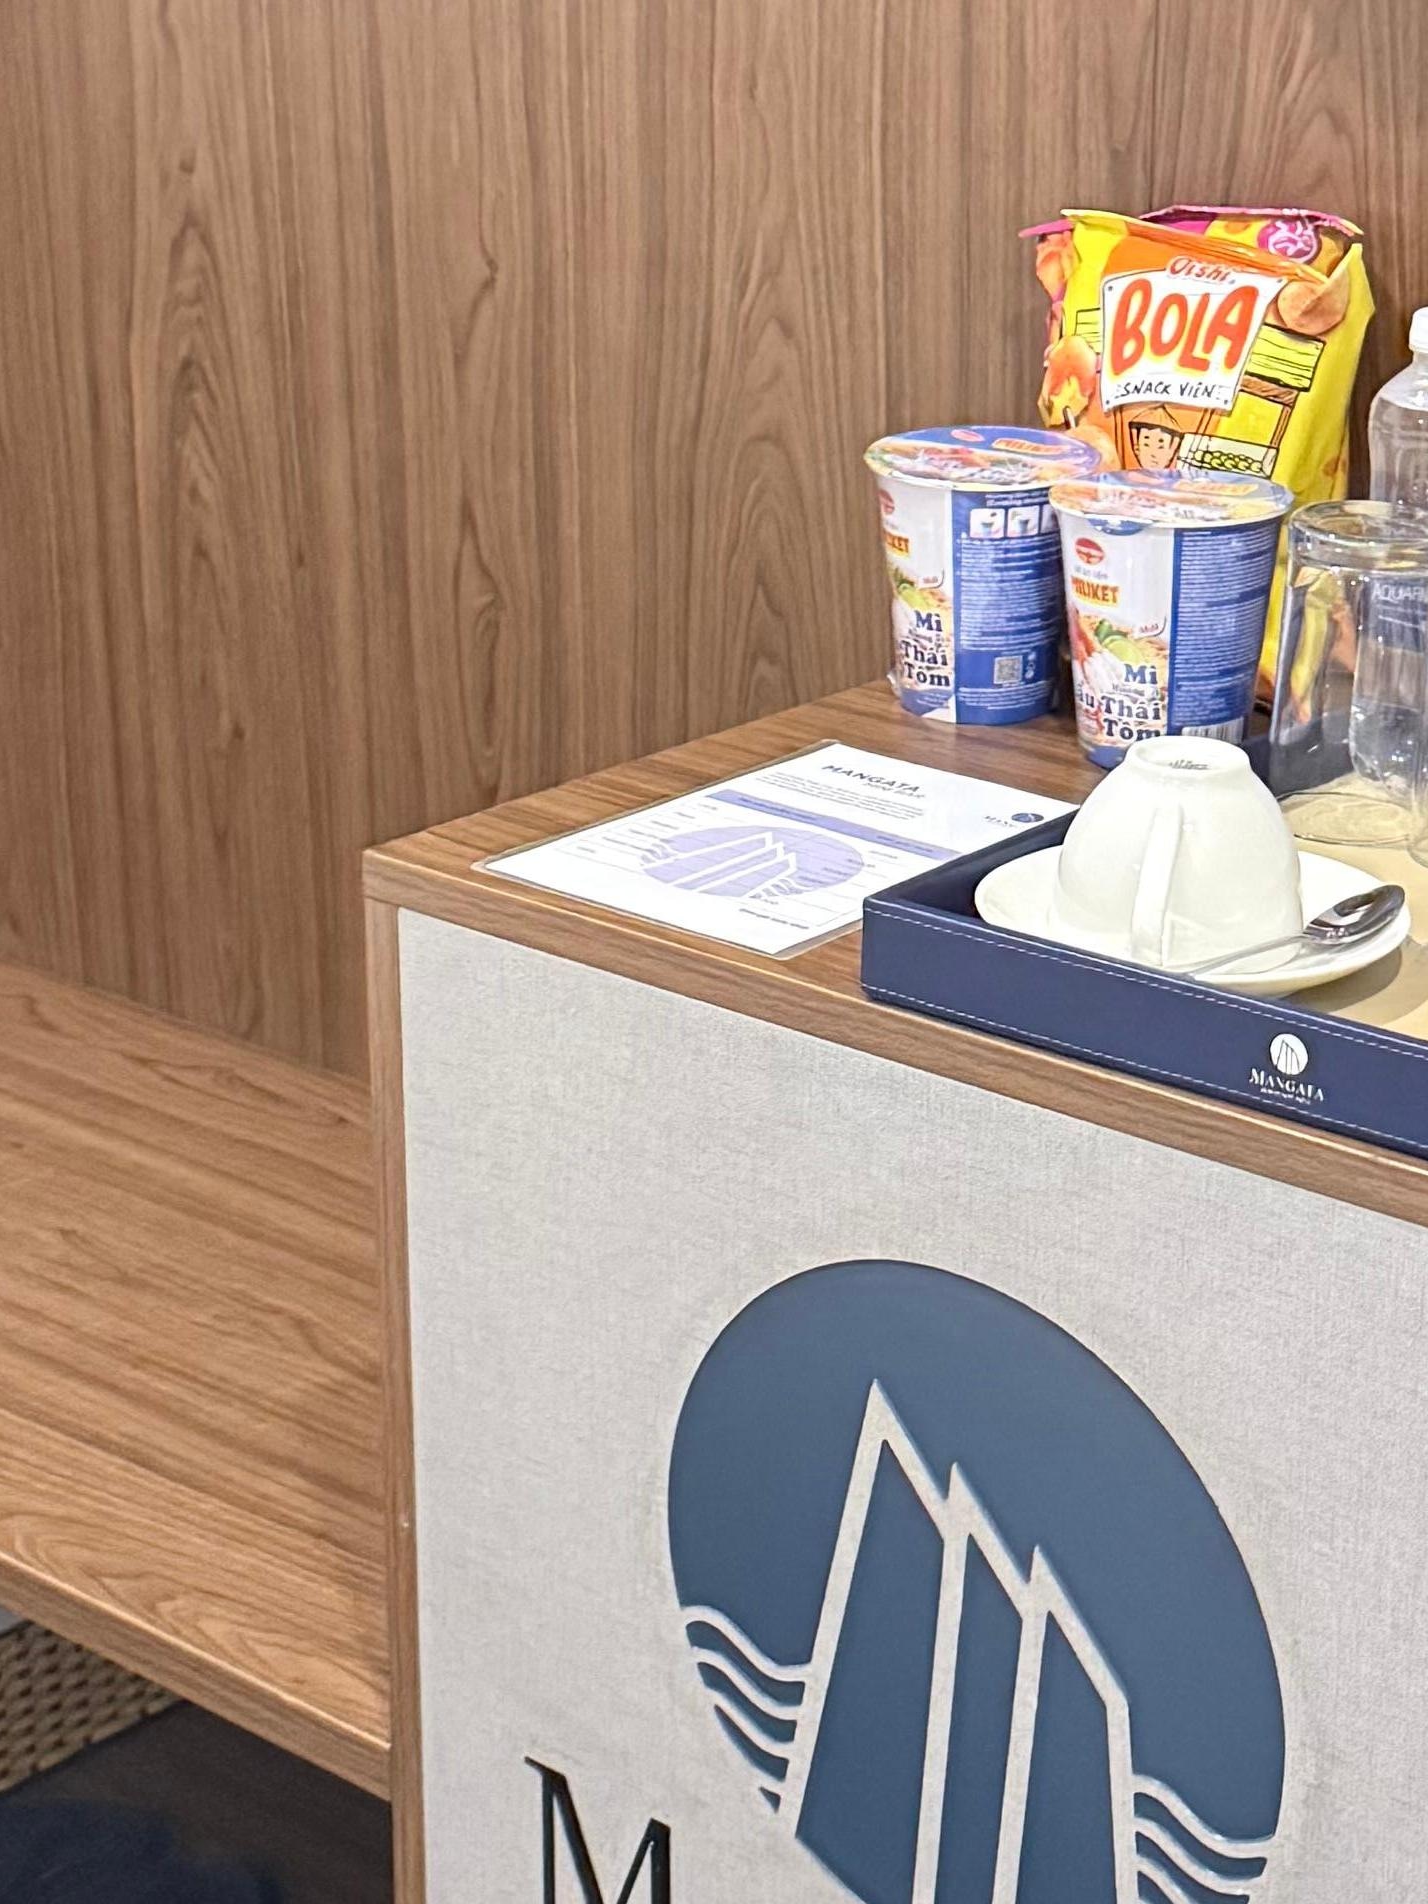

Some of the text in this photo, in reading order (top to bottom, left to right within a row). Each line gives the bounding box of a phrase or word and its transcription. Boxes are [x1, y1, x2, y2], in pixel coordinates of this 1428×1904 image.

[1110, 278, 1260, 376] BOLA
[1121, 381, 1171, 398] SNACK
[821, 764, 921, 793] MANGATA
[1248, 1067, 1324, 1102] MANGATA
